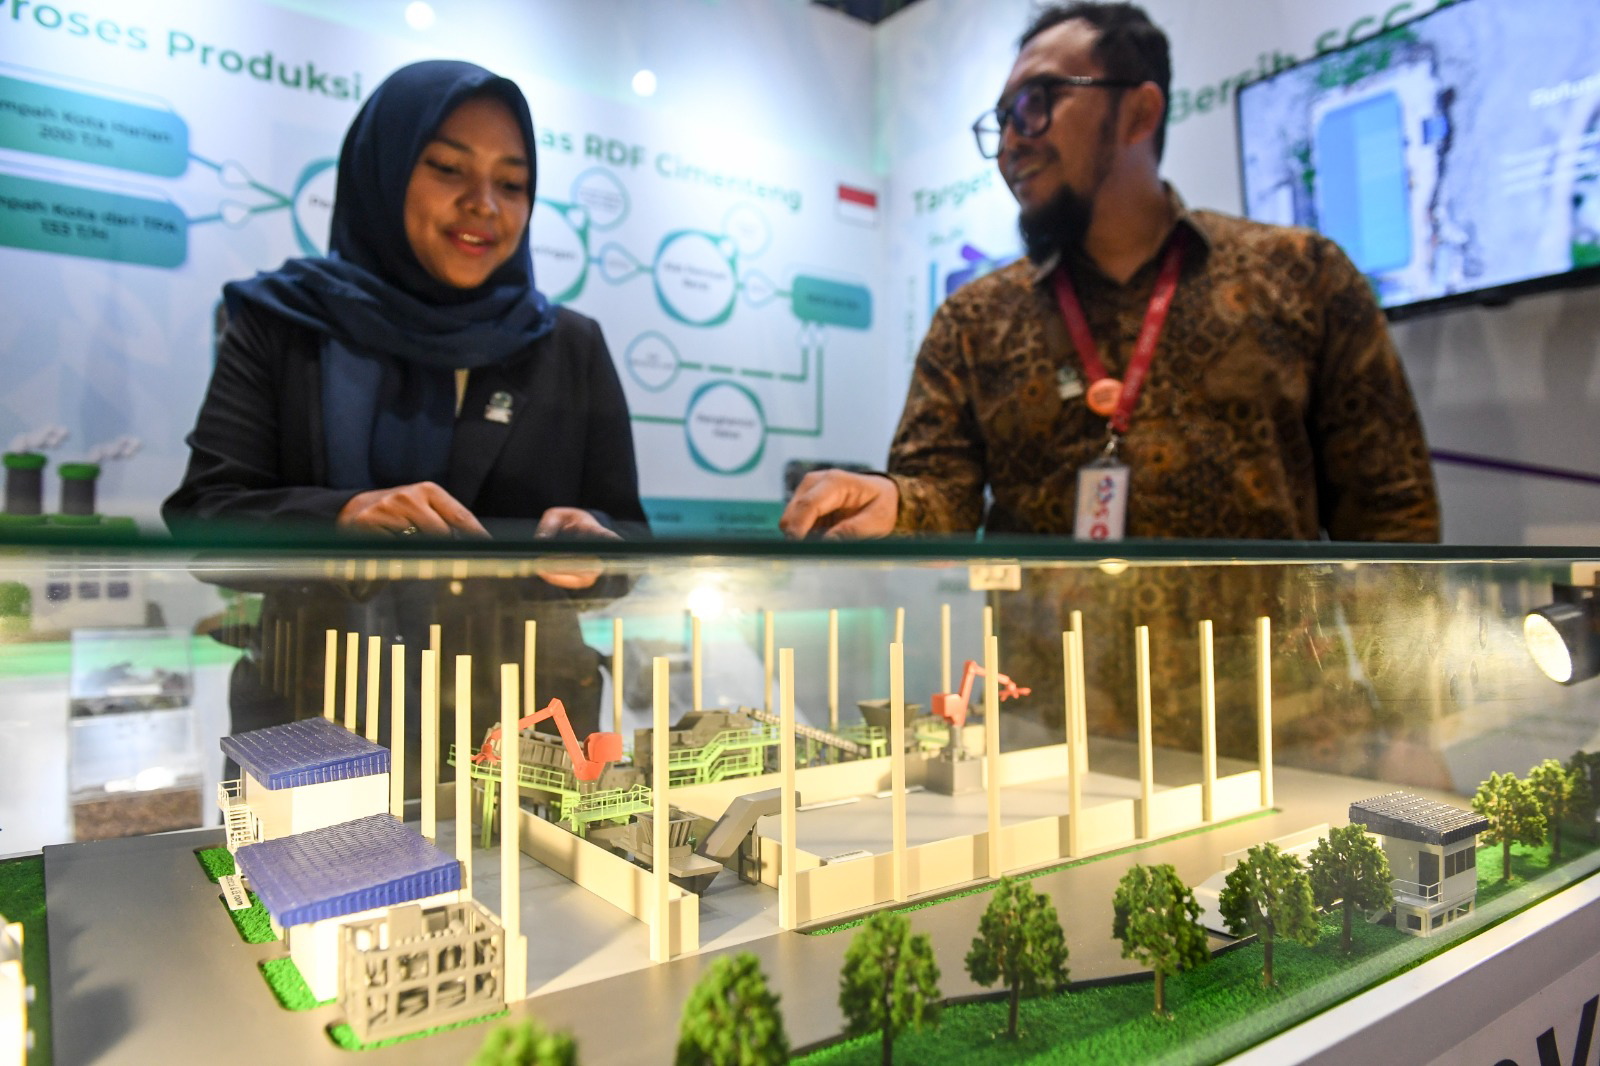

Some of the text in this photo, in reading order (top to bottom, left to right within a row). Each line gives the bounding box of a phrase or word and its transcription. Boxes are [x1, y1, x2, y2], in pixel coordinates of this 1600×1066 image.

[0, 0, 362, 102] roses Produksi
[0, 99, 57, 119] mpah
[541, 129, 573, 152] as
[583, 132, 645, 170] RDF
[655, 150, 803, 215] Cimenteng
